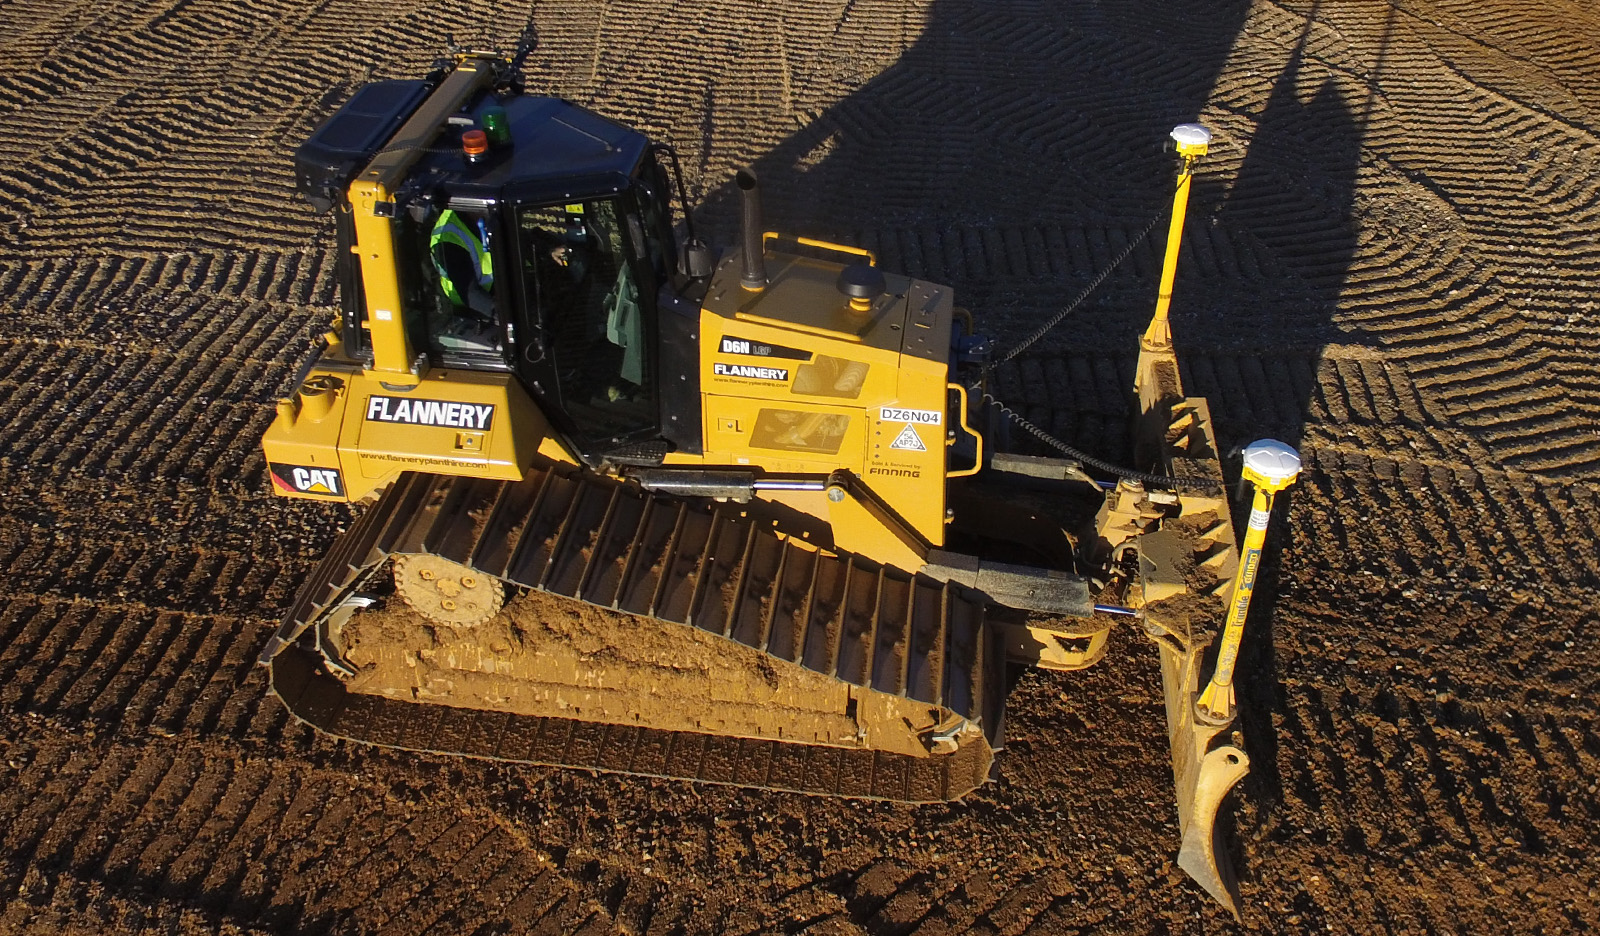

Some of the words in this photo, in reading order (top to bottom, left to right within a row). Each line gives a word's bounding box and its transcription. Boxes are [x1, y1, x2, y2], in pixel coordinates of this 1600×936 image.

[723, 339, 750, 354] D6N
[752, 345, 772, 356] LGP
[714, 363, 787, 380] FLANNERY
[366, 397, 493, 429] FLANNERY
[882, 408, 939, 423] DZ6N04
[360, 452, 487, 470] www.flanneryplanthire.com
[292, 467, 338, 494] CAT
[869, 467, 921, 478] FINNING
[1231, 595, 1250, 627] Trimble
[1244, 552, 1258, 584] GUIDED
